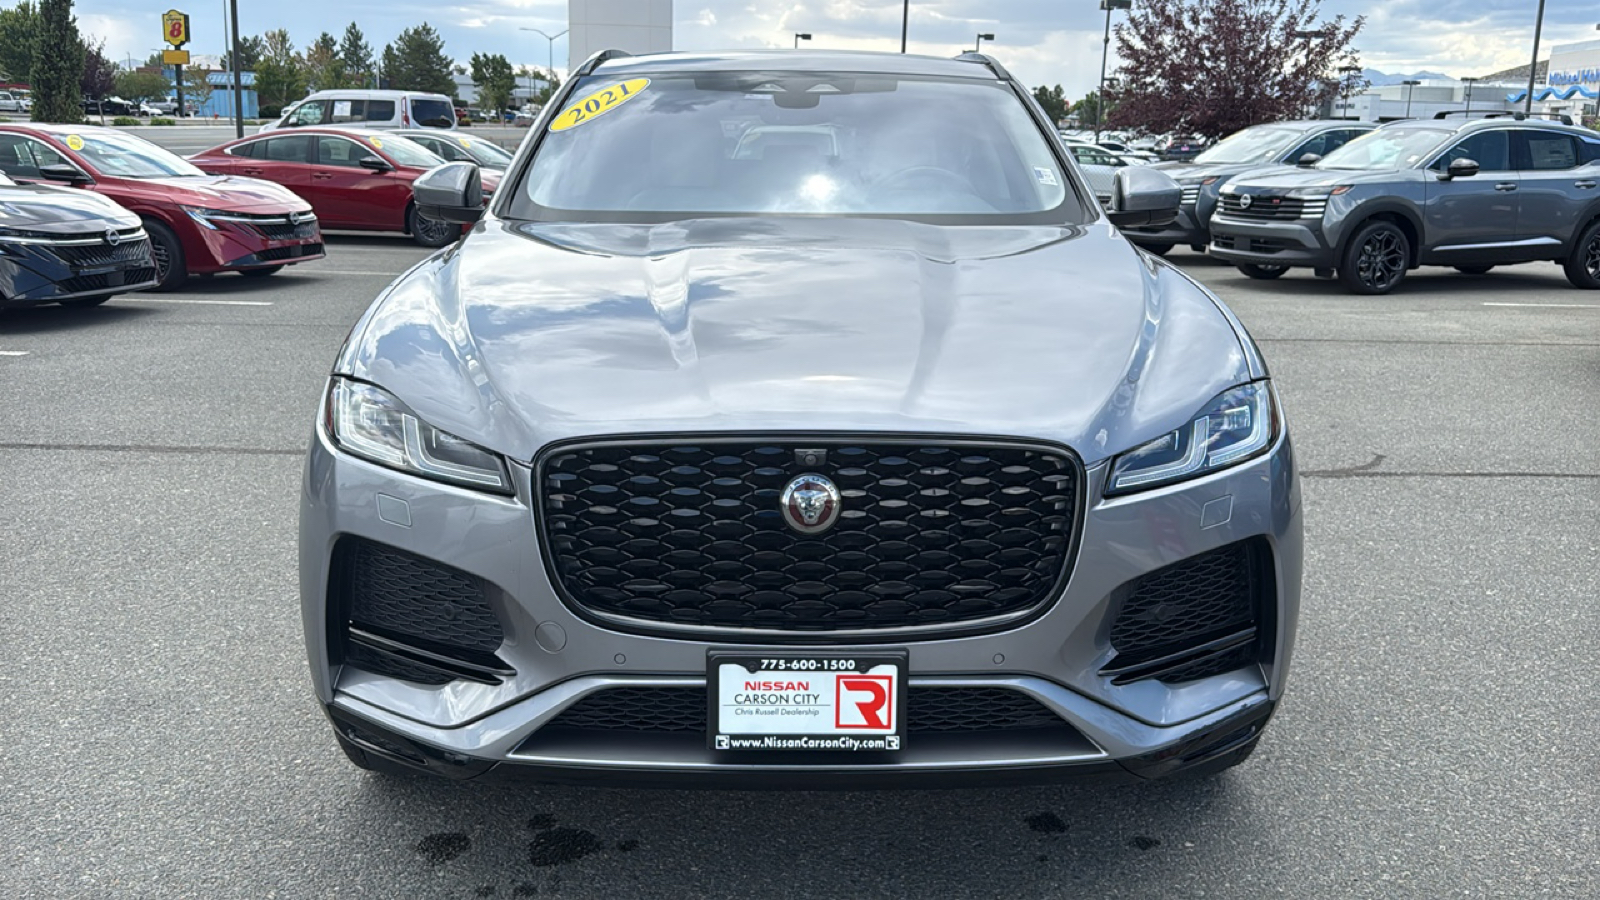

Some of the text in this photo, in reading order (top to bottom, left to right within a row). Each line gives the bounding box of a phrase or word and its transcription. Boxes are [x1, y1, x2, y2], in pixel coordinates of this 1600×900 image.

[169, 21, 182, 38] 8
[569, 83, 630, 124] 2021
[760, 659, 856, 670] 775-600-1500
[744, 681, 810, 691] NISSAN
[734, 693, 820, 705] CARSON CITY
[841, 680, 887, 728] R
[734, 707, 820, 717] Chris Russell Dealership
[730, 737, 885, 751] www.NissanCarsonCity.com
